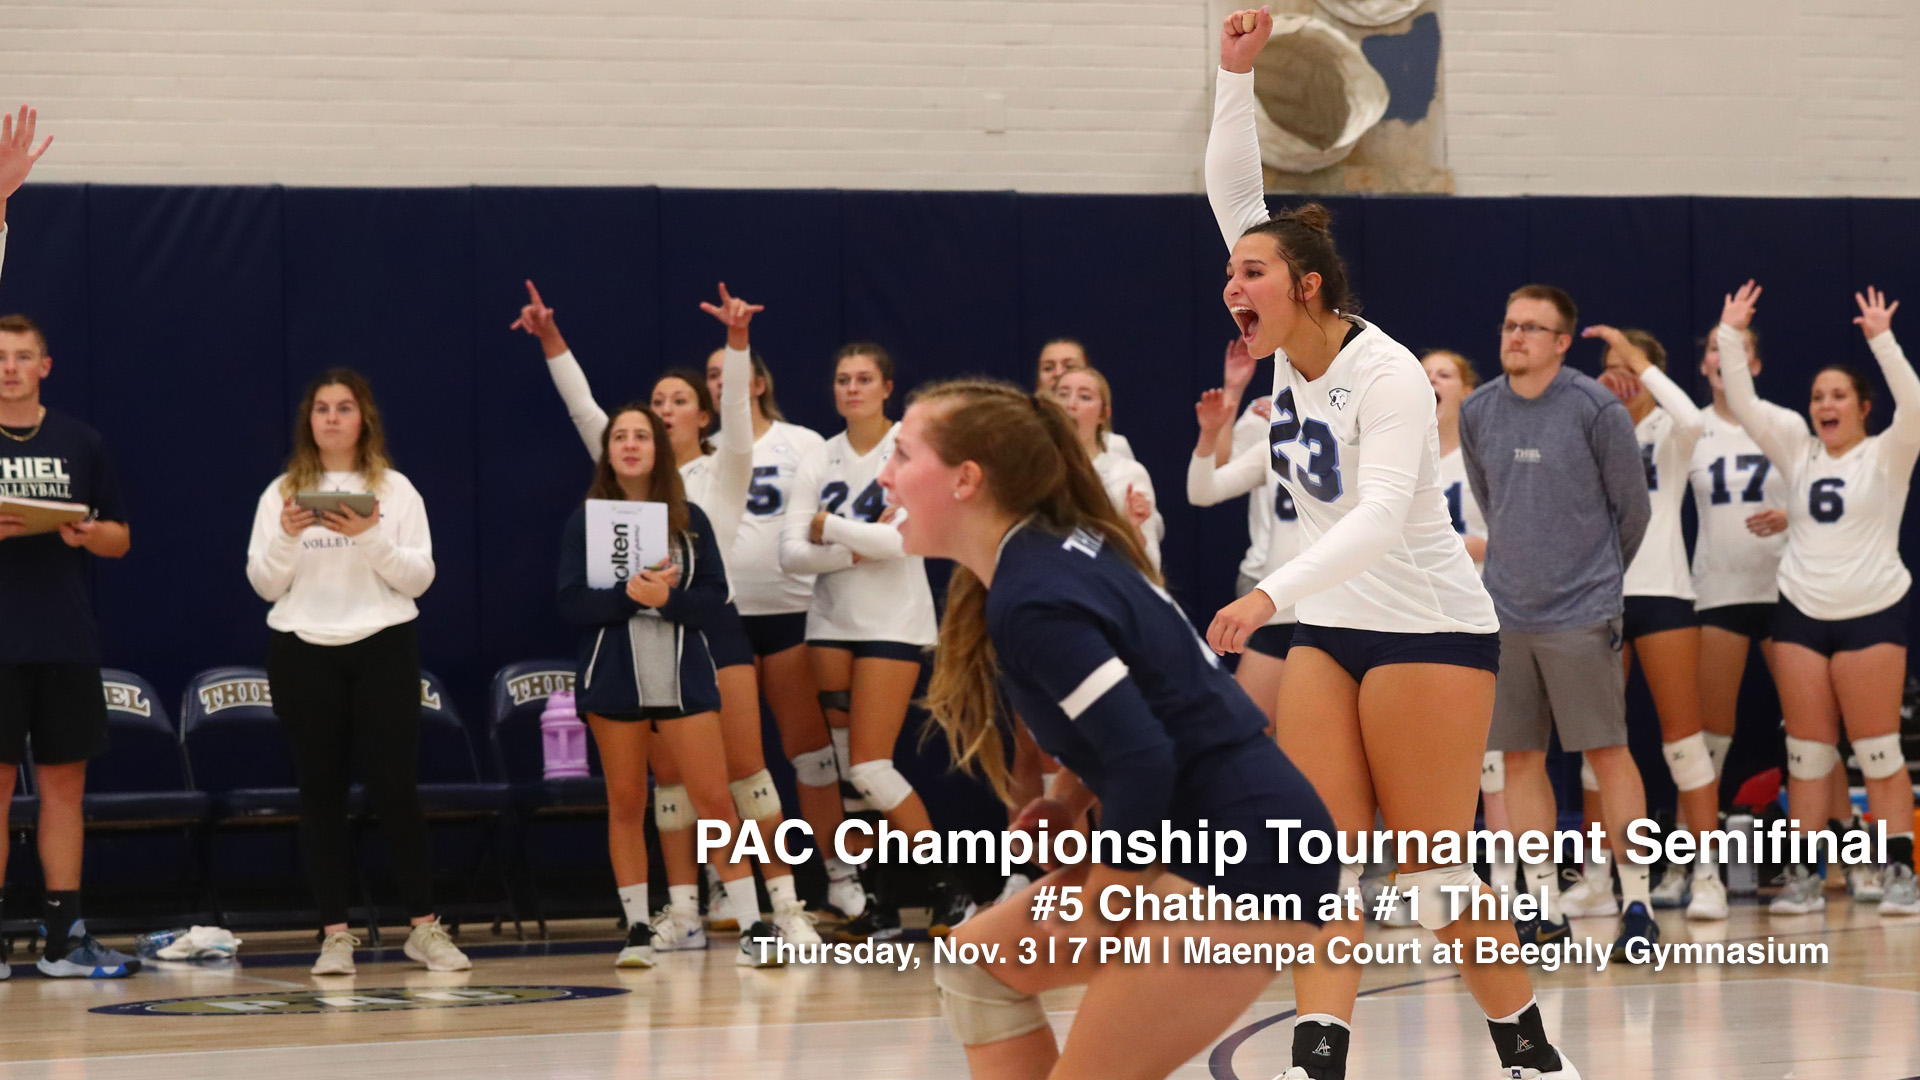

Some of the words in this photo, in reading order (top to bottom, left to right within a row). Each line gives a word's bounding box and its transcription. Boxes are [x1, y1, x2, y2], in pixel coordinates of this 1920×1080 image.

[0, 456, 70, 479] HIEL
[1269, 385, 1344, 503] 23
[745, 465, 783, 516] 5
[820, 478, 887, 523] 24
[1708, 454, 1771, 505] 17
[1808, 477, 1846, 523] 6
[302, 537, 356, 550] VOLLEY
[610, 523, 630, 580] olten
